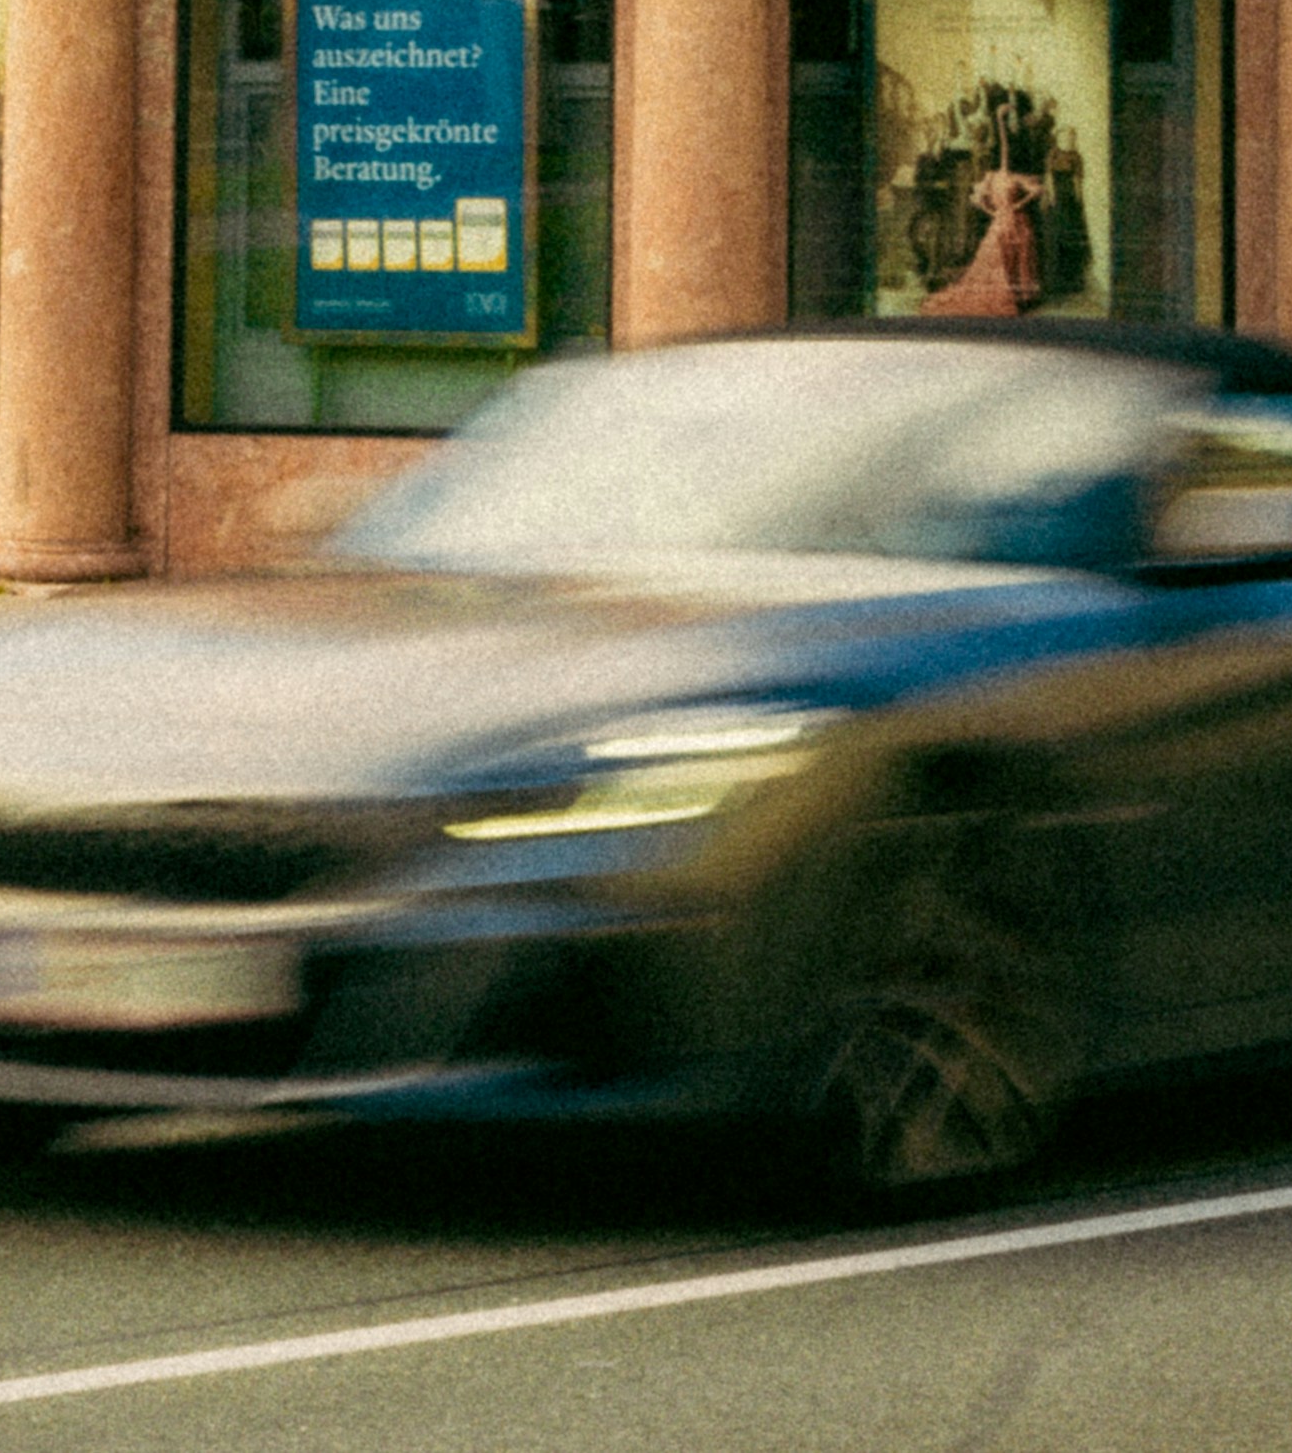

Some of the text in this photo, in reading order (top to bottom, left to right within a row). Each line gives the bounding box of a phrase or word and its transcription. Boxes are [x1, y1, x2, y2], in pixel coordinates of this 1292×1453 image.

[311, 5, 423, 31] Was uns
[311, 40, 483, 69] auszeichnet?
[313, 80, 371, 106] Eine
[312, 117, 499, 152] preisgekrönte
[313, 155, 442, 190] Beratung.
